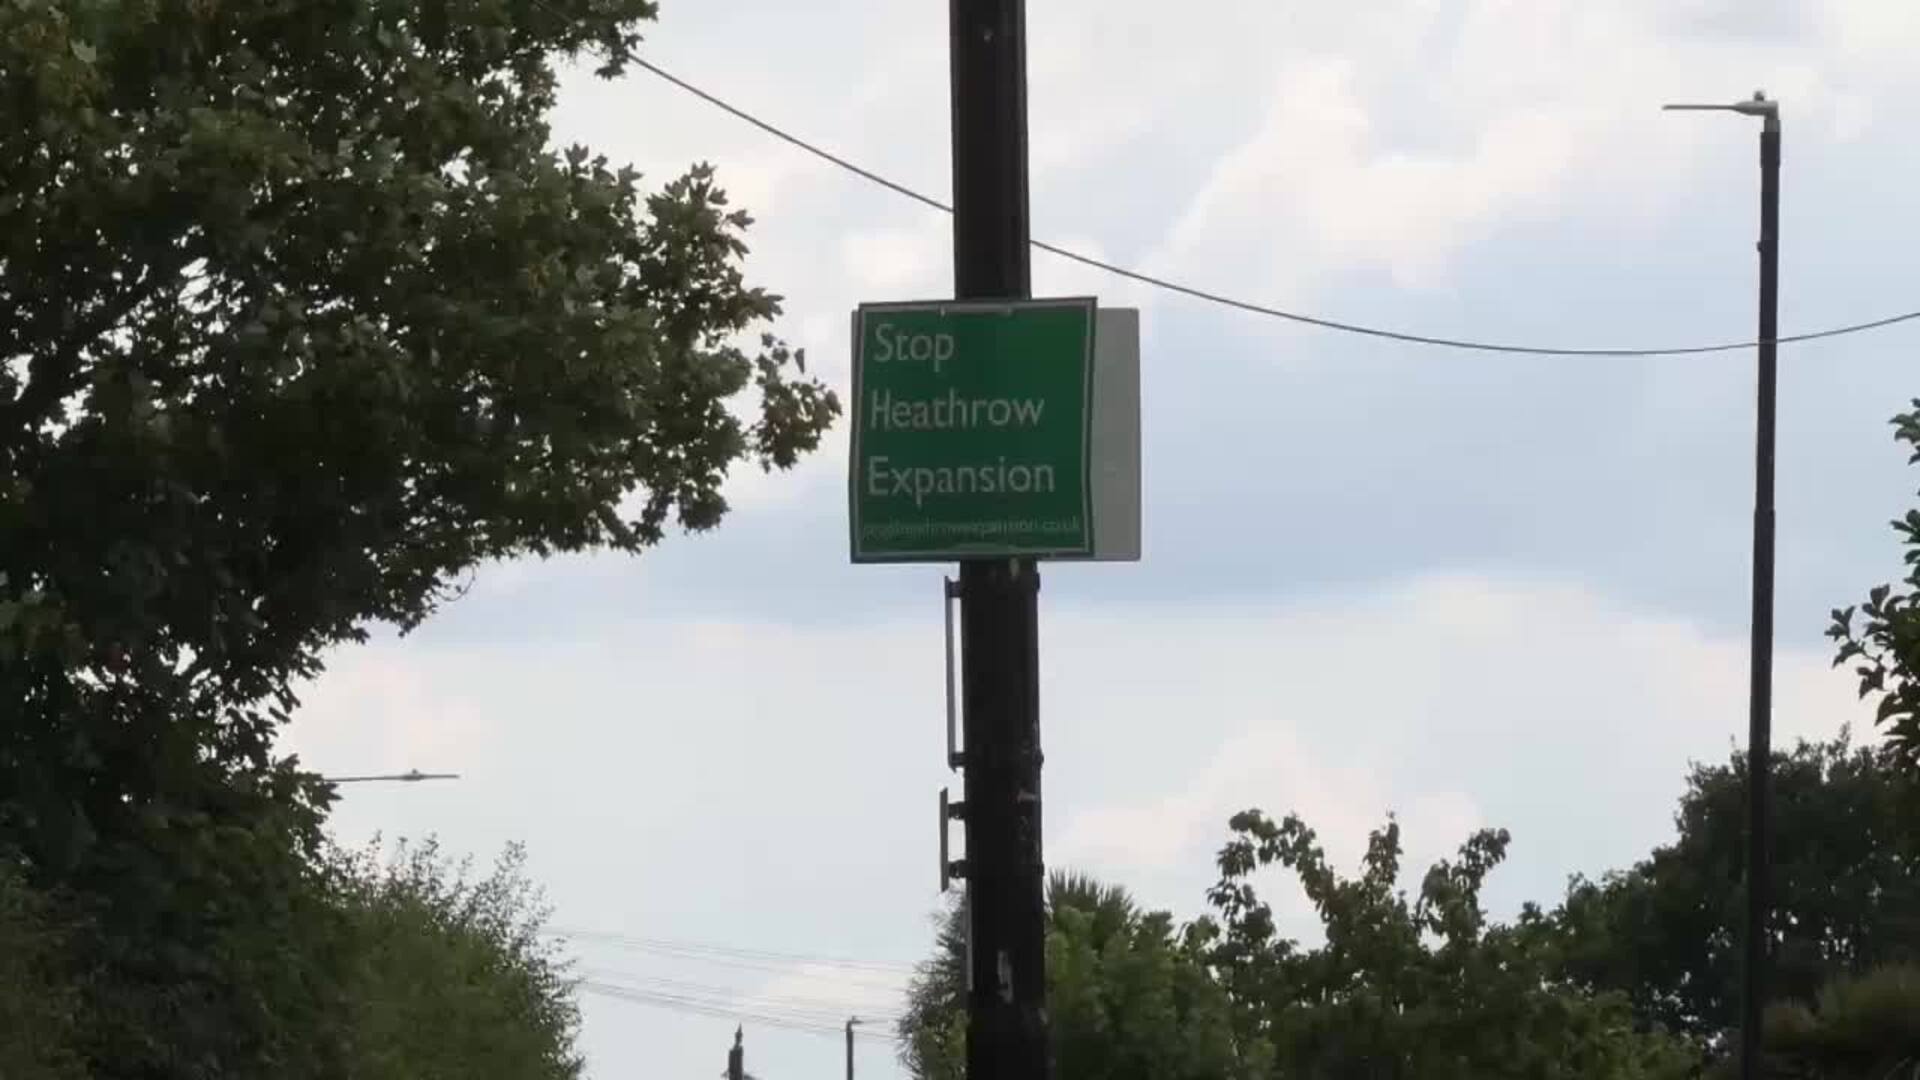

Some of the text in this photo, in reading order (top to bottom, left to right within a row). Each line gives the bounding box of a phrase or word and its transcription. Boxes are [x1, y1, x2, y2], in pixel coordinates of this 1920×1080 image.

[873, 323, 954, 373] Stop
[870, 388, 1045, 430] Heathrow
[867, 455, 1056, 509] Expansion
